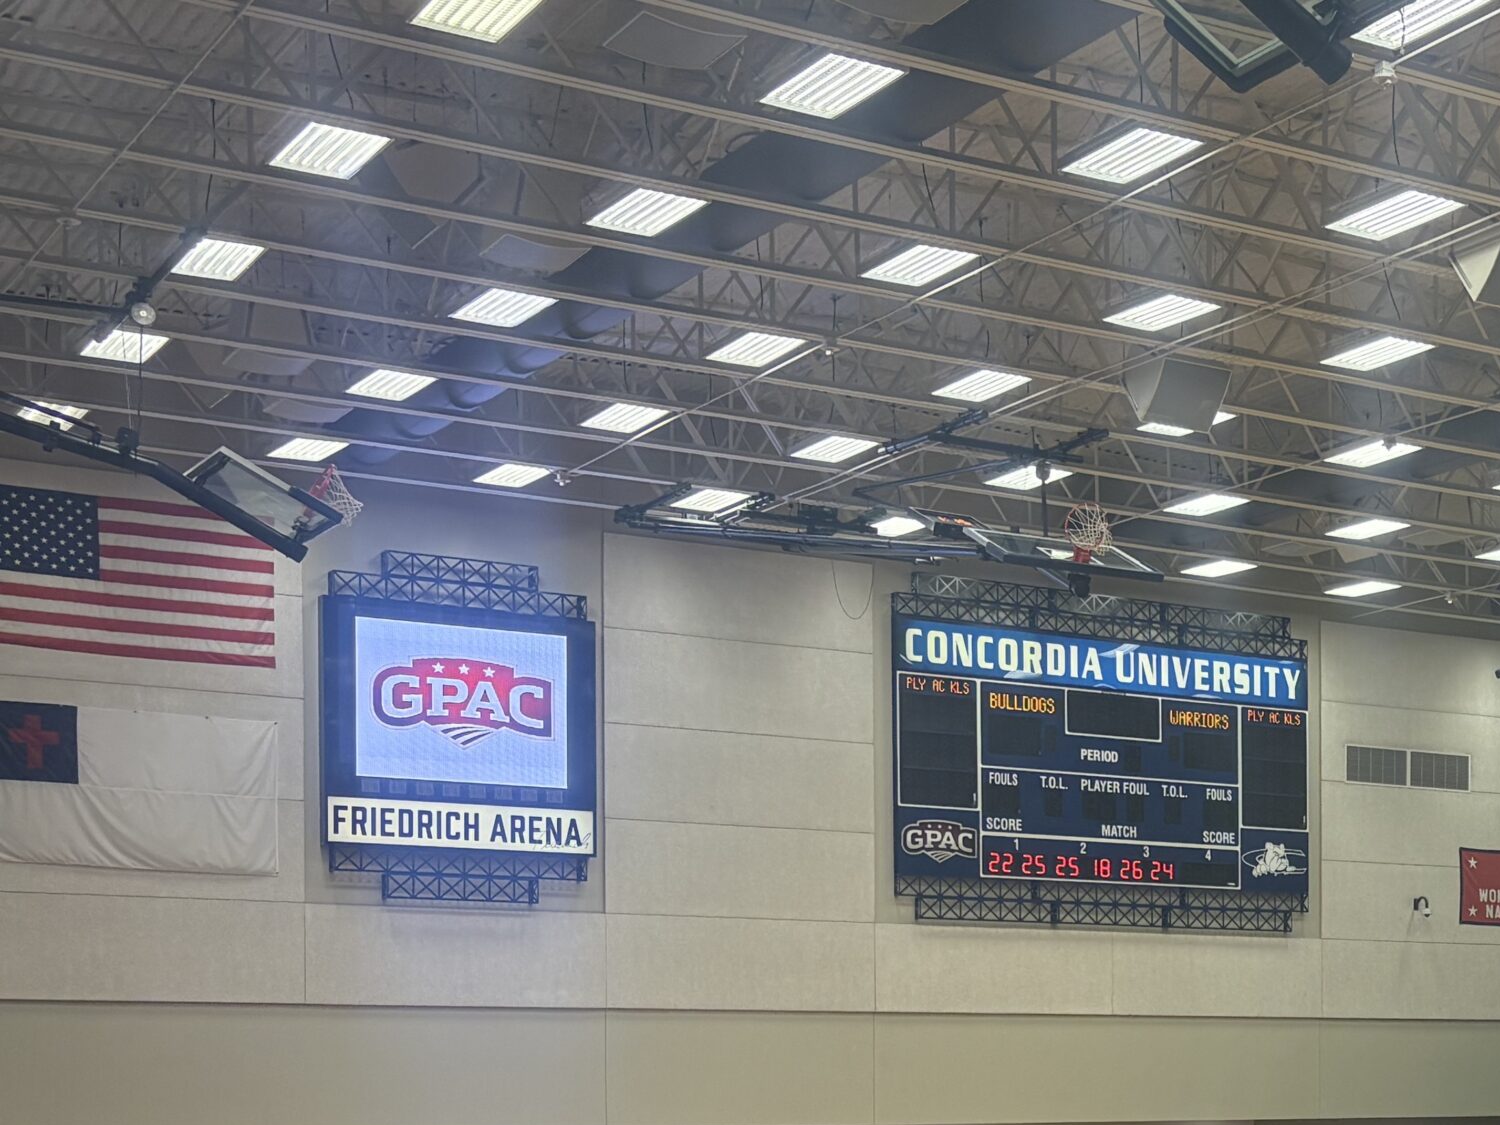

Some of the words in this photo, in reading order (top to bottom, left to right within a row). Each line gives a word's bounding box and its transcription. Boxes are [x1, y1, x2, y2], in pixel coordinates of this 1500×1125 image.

[905, 628, 1103, 681] CONCORDIA
[1115, 650, 1300, 700] UNIVERSITY
[906, 676, 926, 691] PLY
[932, 680, 945, 692] AC
[950, 681, 970, 695] KLS
[380, 675, 545, 729] GPAC
[989, 692, 1056, 714] BULLDOGS
[1169, 709, 1229, 730] WARRIORS
[1247, 709, 1264, 722] PLY
[1269, 712, 1280, 724] AC
[1284, 712, 1301, 726] KLS
[1081, 748, 1118, 763] PERIOD
[989, 771, 1018, 786] FOULS
[1040, 775, 1068, 790] T.O.L.
[1081, 779, 1120, 794] PLAYER
[1123, 781, 1149, 796] FOUL
[1161, 785, 1188, 799] T.O.L.
[1206, 788, 1232, 802] FOULS
[333, 805, 479, 842] FRIEDRICH
[490, 814, 582, 847] ARENA
[986, 817, 1022, 831] SCORE
[1101, 824, 1137, 838] MATCH
[1203, 830, 1235, 844] SCORE
[906, 829, 973, 853] GPAC
[1013, 839, 1019, 851] 1
[1080, 842, 1087, 854] 2
[1143, 846, 1150, 858] 3
[1205, 849, 1211, 861] 4
[988, 852, 1014, 874] 22
[1021, 854, 1046, 875] 25
[1055, 856, 1080, 877] 25
[1094, 858, 1111, 878] 18
[1120, 859, 1143, 880] 26
[1151, 861, 1174, 880] 24
